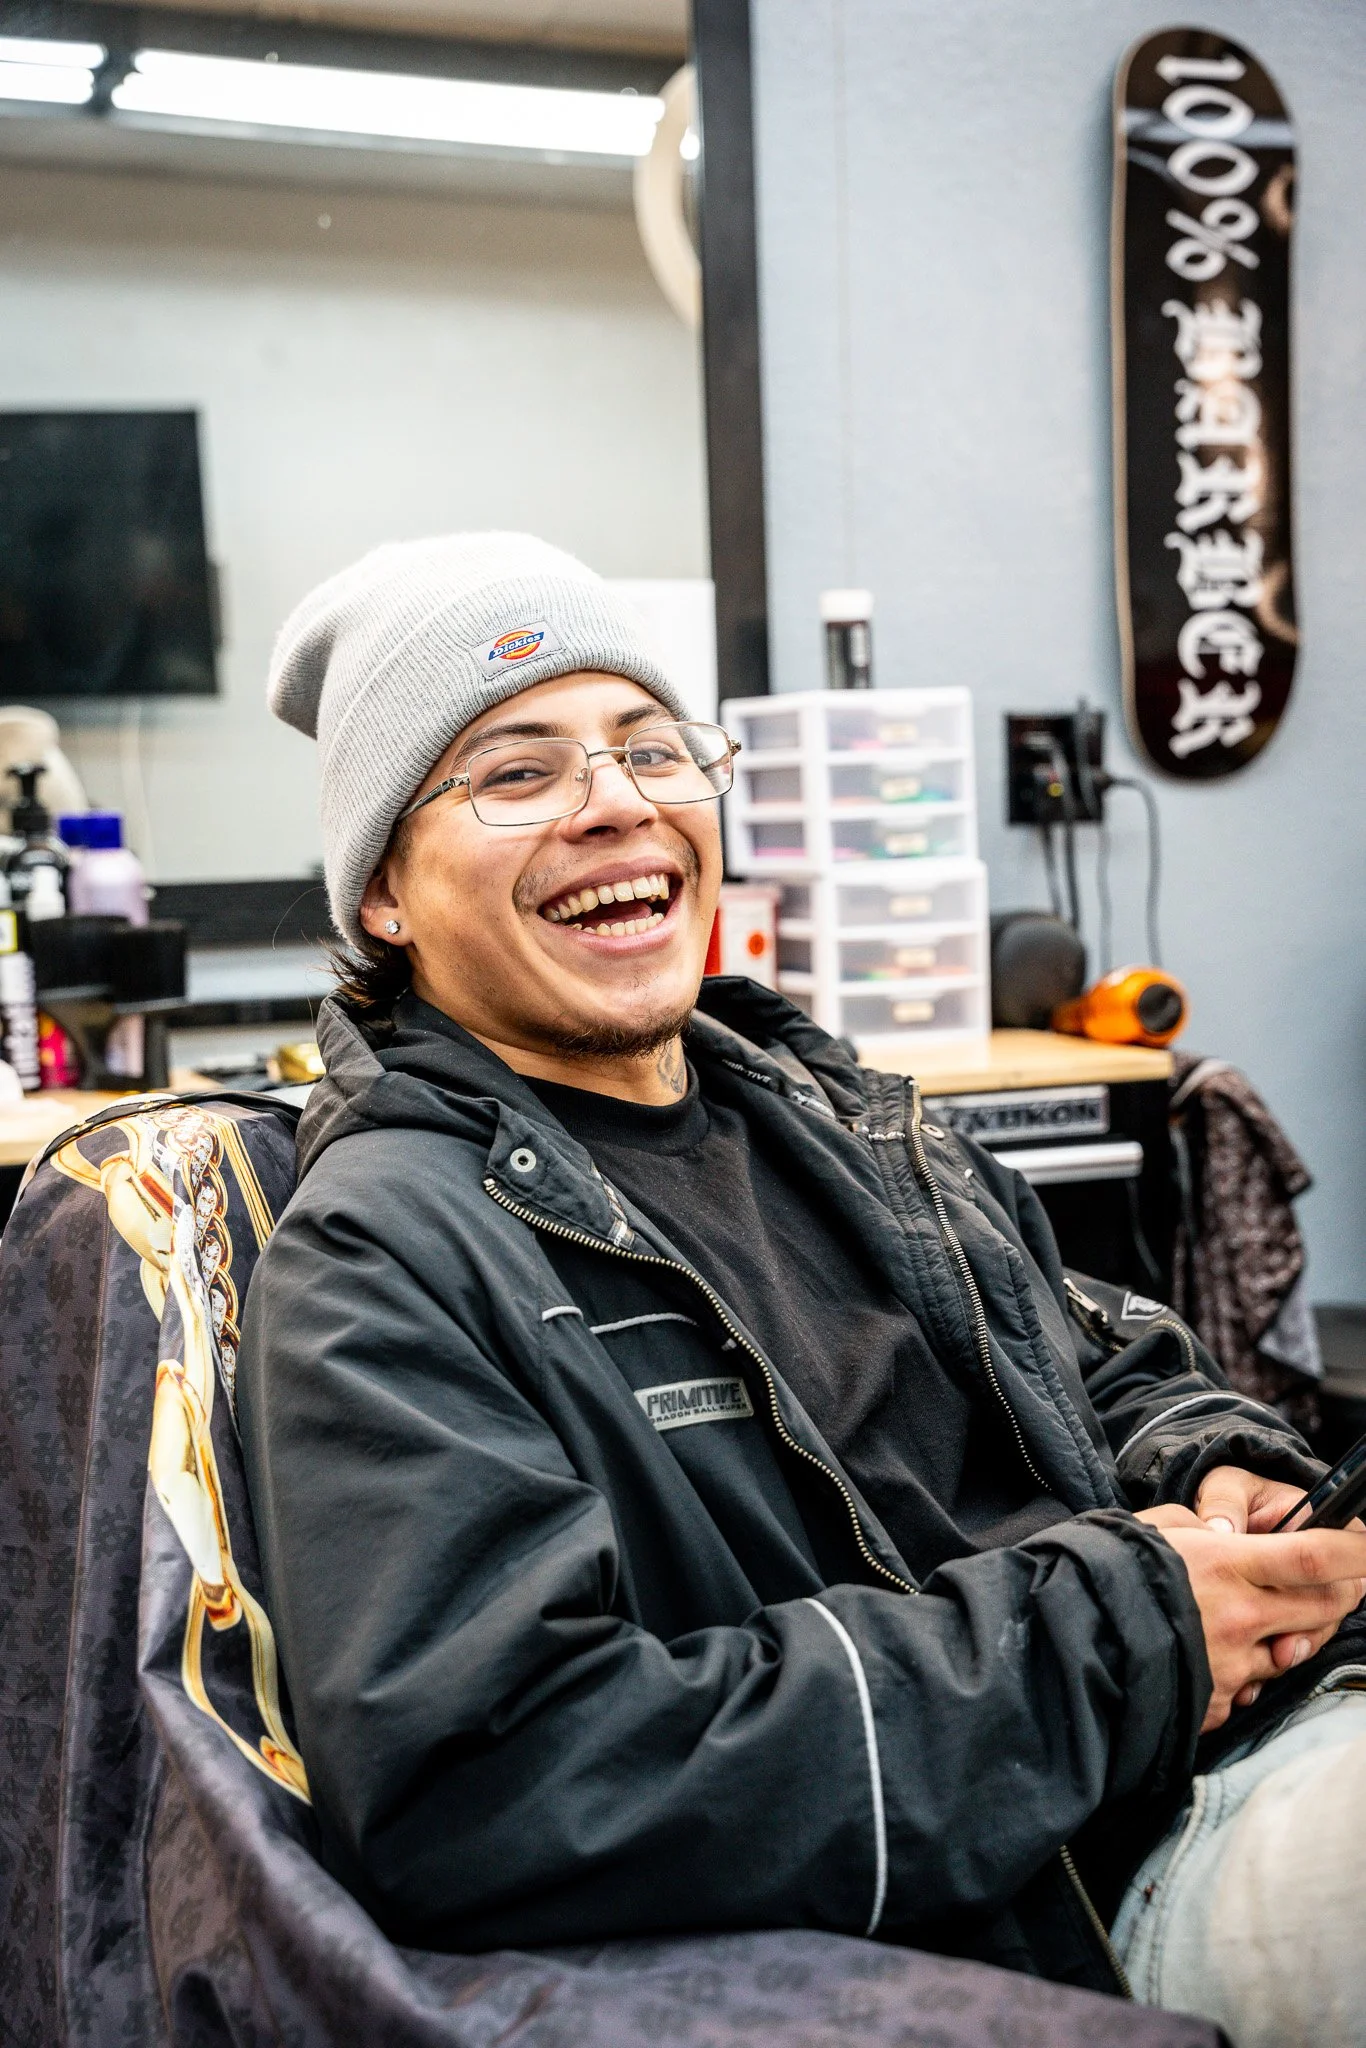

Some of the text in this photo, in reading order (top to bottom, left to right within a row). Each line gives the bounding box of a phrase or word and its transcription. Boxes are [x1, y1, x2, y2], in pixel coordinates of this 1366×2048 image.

[1154, 53, 1264, 760] 100% BARBER
[646, 1382, 742, 1417] PRIMITIVE
